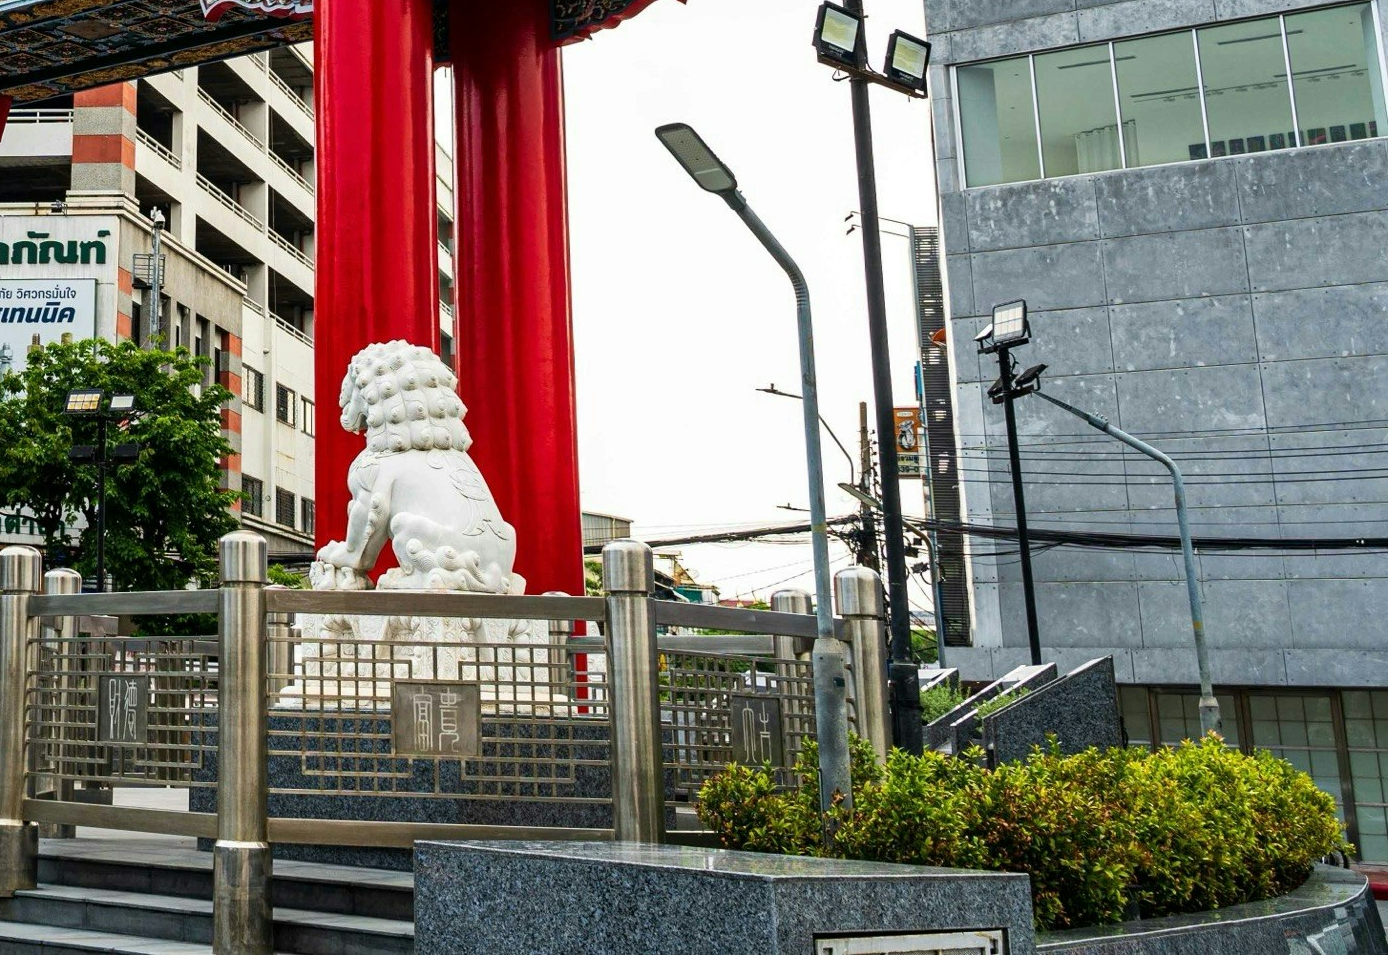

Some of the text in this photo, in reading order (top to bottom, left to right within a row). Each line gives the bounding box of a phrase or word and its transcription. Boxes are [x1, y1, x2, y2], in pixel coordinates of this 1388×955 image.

[16, 284, 77, 299] วิศวกรมั่นใจ
